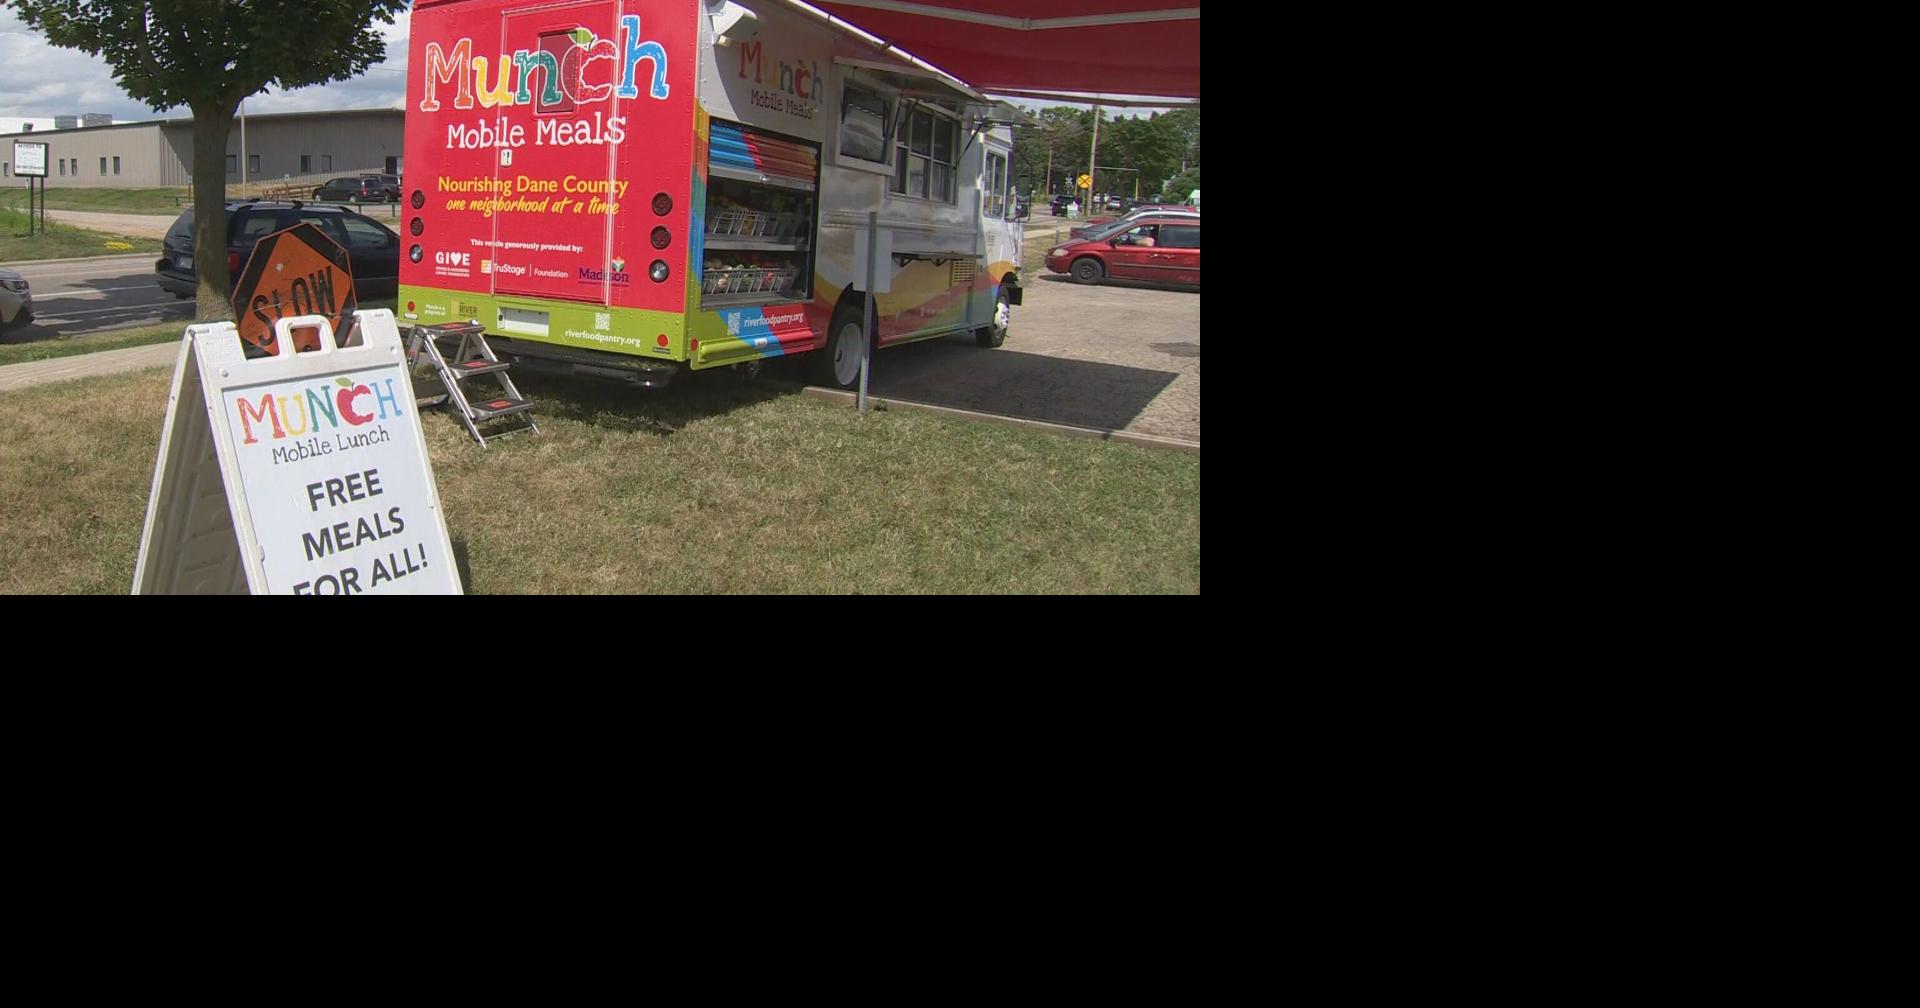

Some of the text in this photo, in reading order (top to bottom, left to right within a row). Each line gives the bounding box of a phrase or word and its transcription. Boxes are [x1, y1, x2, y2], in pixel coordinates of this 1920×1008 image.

[420, 15, 669, 112] Munch
[738, 40, 823, 104] Munch
[750, 89, 814, 120] Mobile Meals
[447, 112, 627, 149] Mobile Meals
[438, 175, 629, 198] Nourishing Dane County
[447, 196, 620, 218] one neighborhood at a time
[505, 242, 539, 251] generously
[541, 244, 571, 252] provided
[534, 268, 568, 278] Foundation
[744, 312, 804, 327] riverfoodpantry.org
[565, 330, 641, 348] riverfoodpantry.org
[236, 377, 403, 445] MUNCH
[272, 425, 390, 465] Mobile Lunch
[306, 468, 383, 512] FREE
[302, 506, 405, 561] MEALS
[371, 543, 428, 587] ALL!
